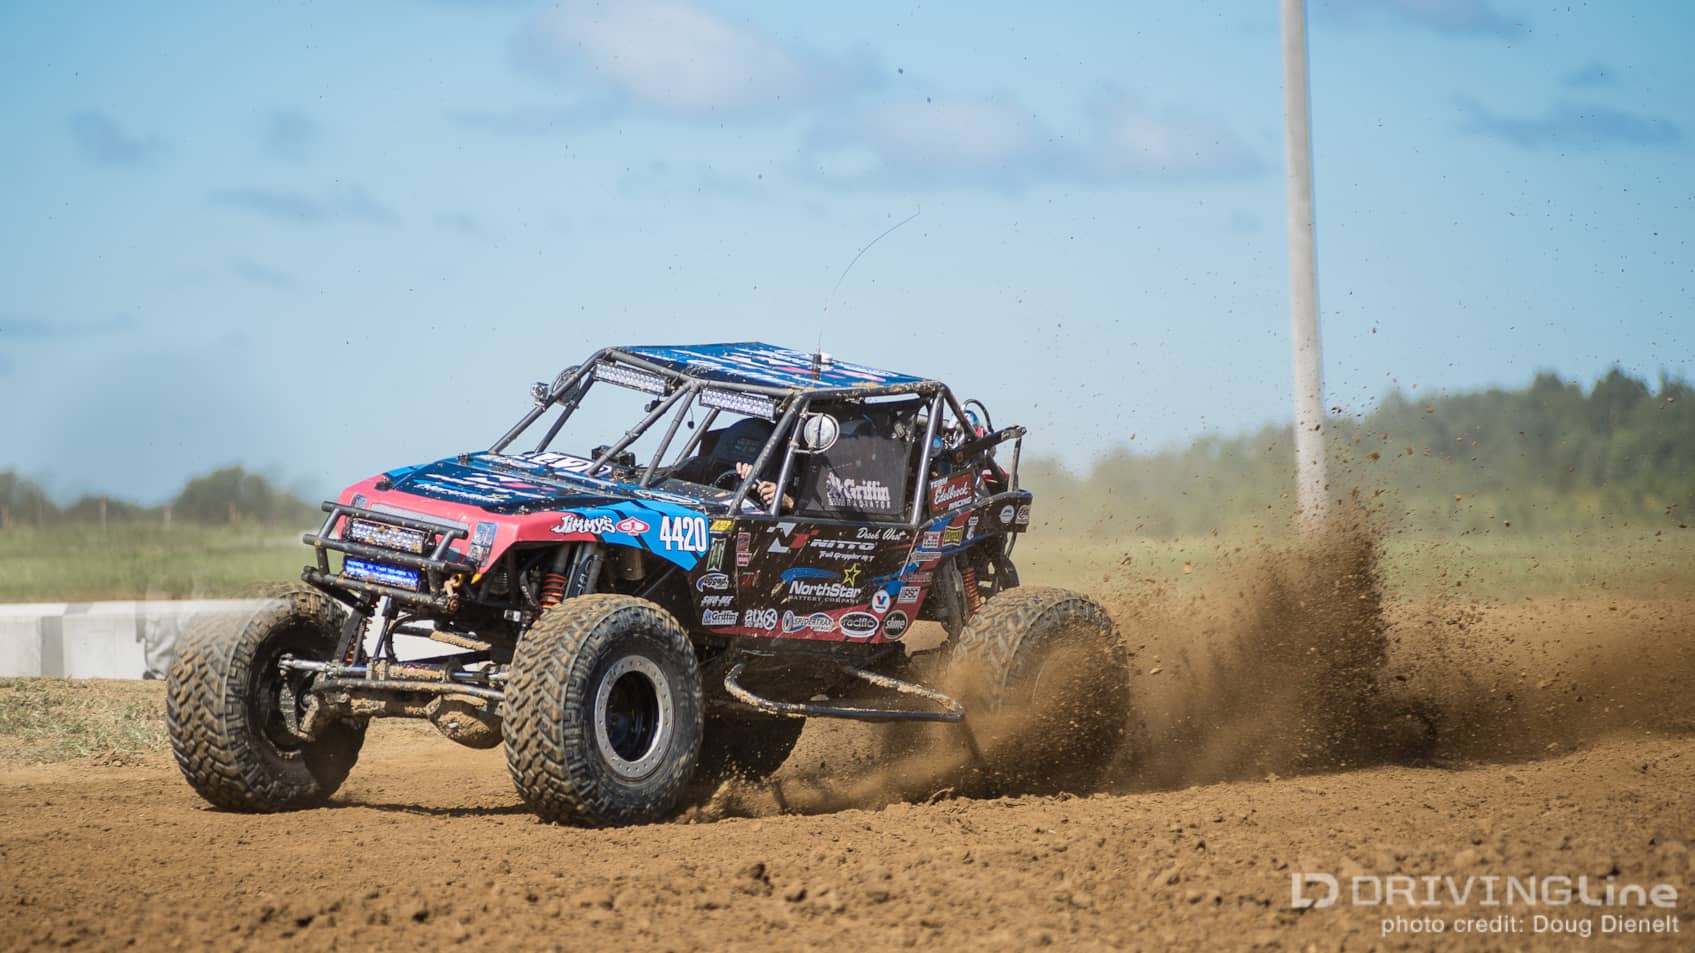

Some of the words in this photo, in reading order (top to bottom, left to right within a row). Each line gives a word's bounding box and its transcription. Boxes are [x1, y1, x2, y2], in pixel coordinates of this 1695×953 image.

[843, 478, 890, 501] Griffin
[659, 515, 707, 551] 4420
[788, 580, 861, 599] NorthStar
